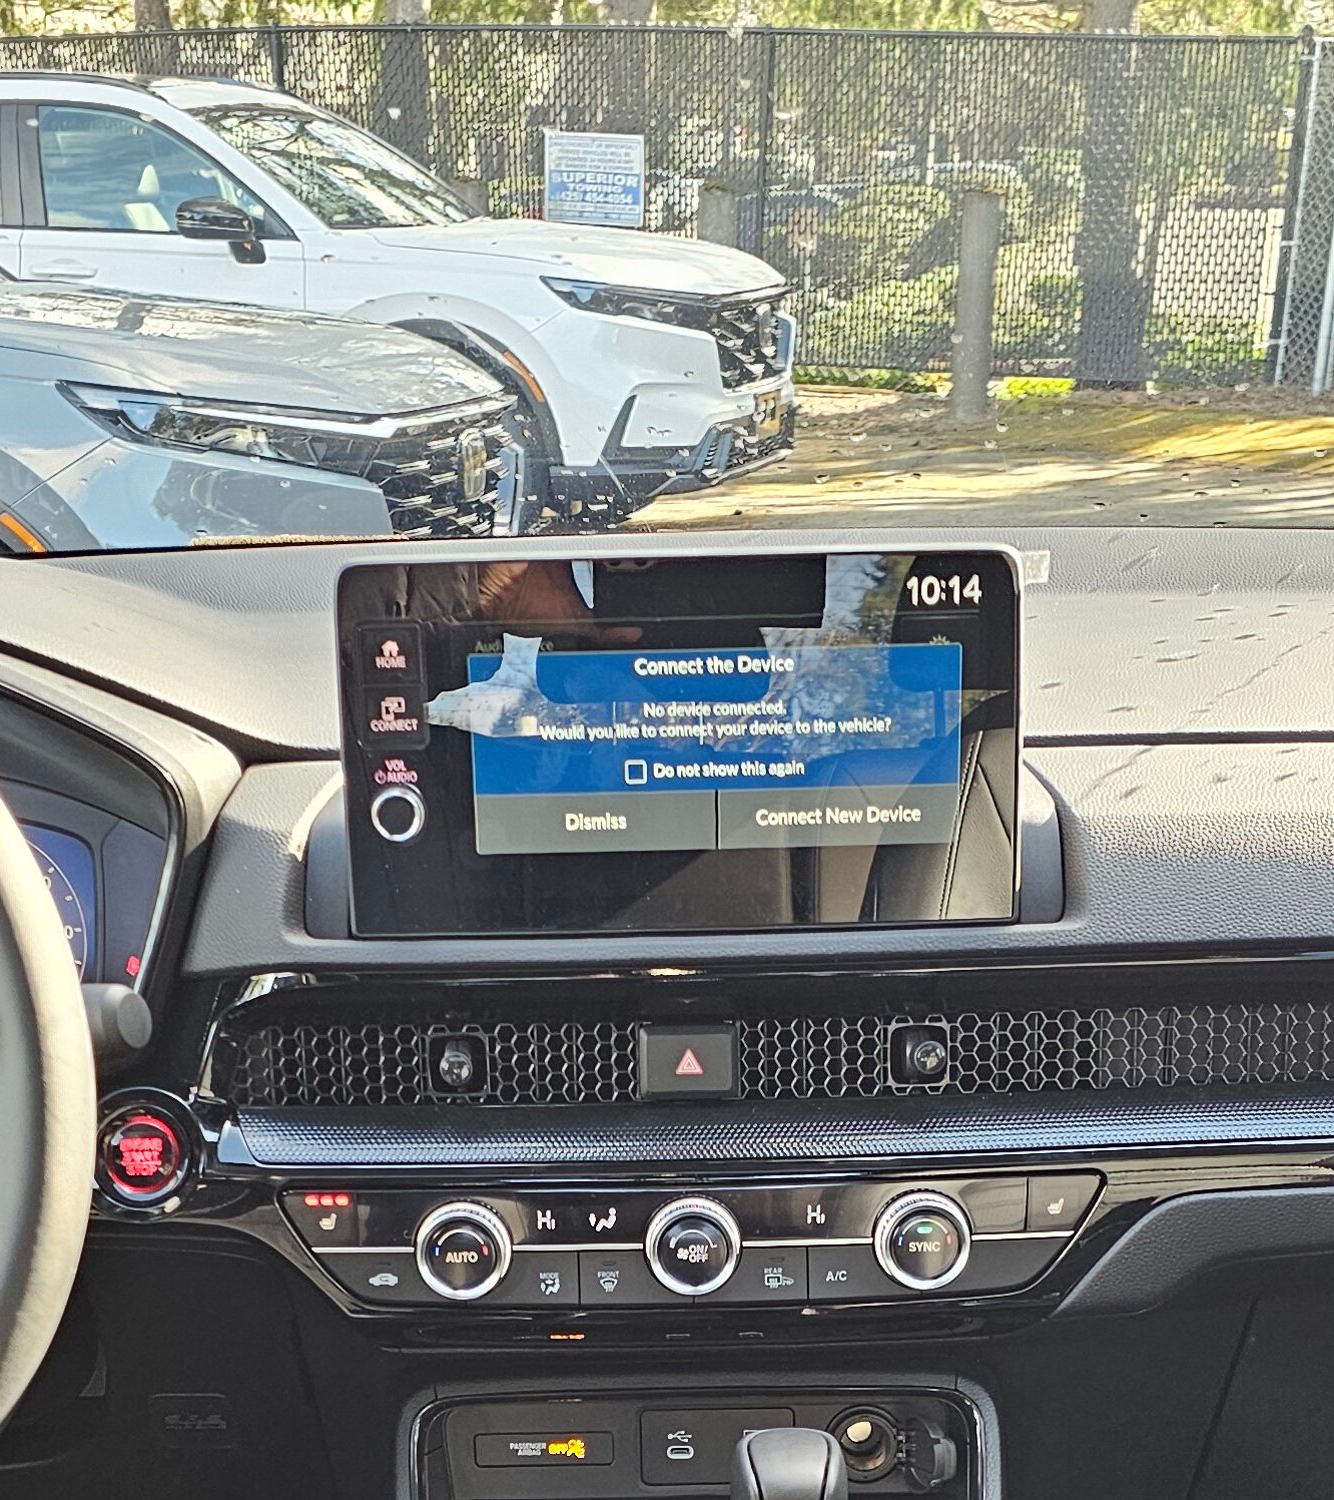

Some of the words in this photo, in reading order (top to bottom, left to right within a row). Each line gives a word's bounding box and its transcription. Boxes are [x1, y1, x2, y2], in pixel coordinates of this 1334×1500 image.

[551, 172, 639, 187] SUPERIOR
[566, 183, 624, 194] TOWING
[906, 575, 983, 607] 10:14
[375, 655, 406, 669] HOME
[633, 657, 703, 678] Connect
[706, 656, 734, 675] the
[737, 655, 795, 673] Device
[643, 703, 665, 718] No
[667, 702, 711, 718] device
[370, 718, 418, 732] CONNECT
[539, 724, 585, 741] Would
[588, 727, 613, 743] you
[616, 724, 640, 739] like
[642, 725, 657, 739] to
[659, 723, 713, 738] connect
[716, 724, 747, 739] your
[750, 720, 793, 736] device
[796, 720, 811, 735] to
[813, 719, 837, 735] the
[839, 717, 892, 733] vehicle?
[385, 759, 407, 772] VOL
[653, 763, 674, 779] Do
[677, 763, 701, 778] not
[703, 761, 739, 778] show
[741, 760, 767, 777] this
[769, 760, 805, 778] again
[387, 770, 418, 784] AUDIO
[565, 811, 628, 833] Dismiss
[755, 806, 820, 829] Connect
[824, 805, 861, 827] New
[866, 803, 922, 825] Device
[688, 1244, 709, 1255] ON/
[908, 1241, 941, 1253] SYNC
[445, 1251, 479, 1265] AUTO
[688, 1253, 709, 1263] OFF
[597, 1270, 620, 1278] FRONT
[825, 1270, 848, 1282] A/C
